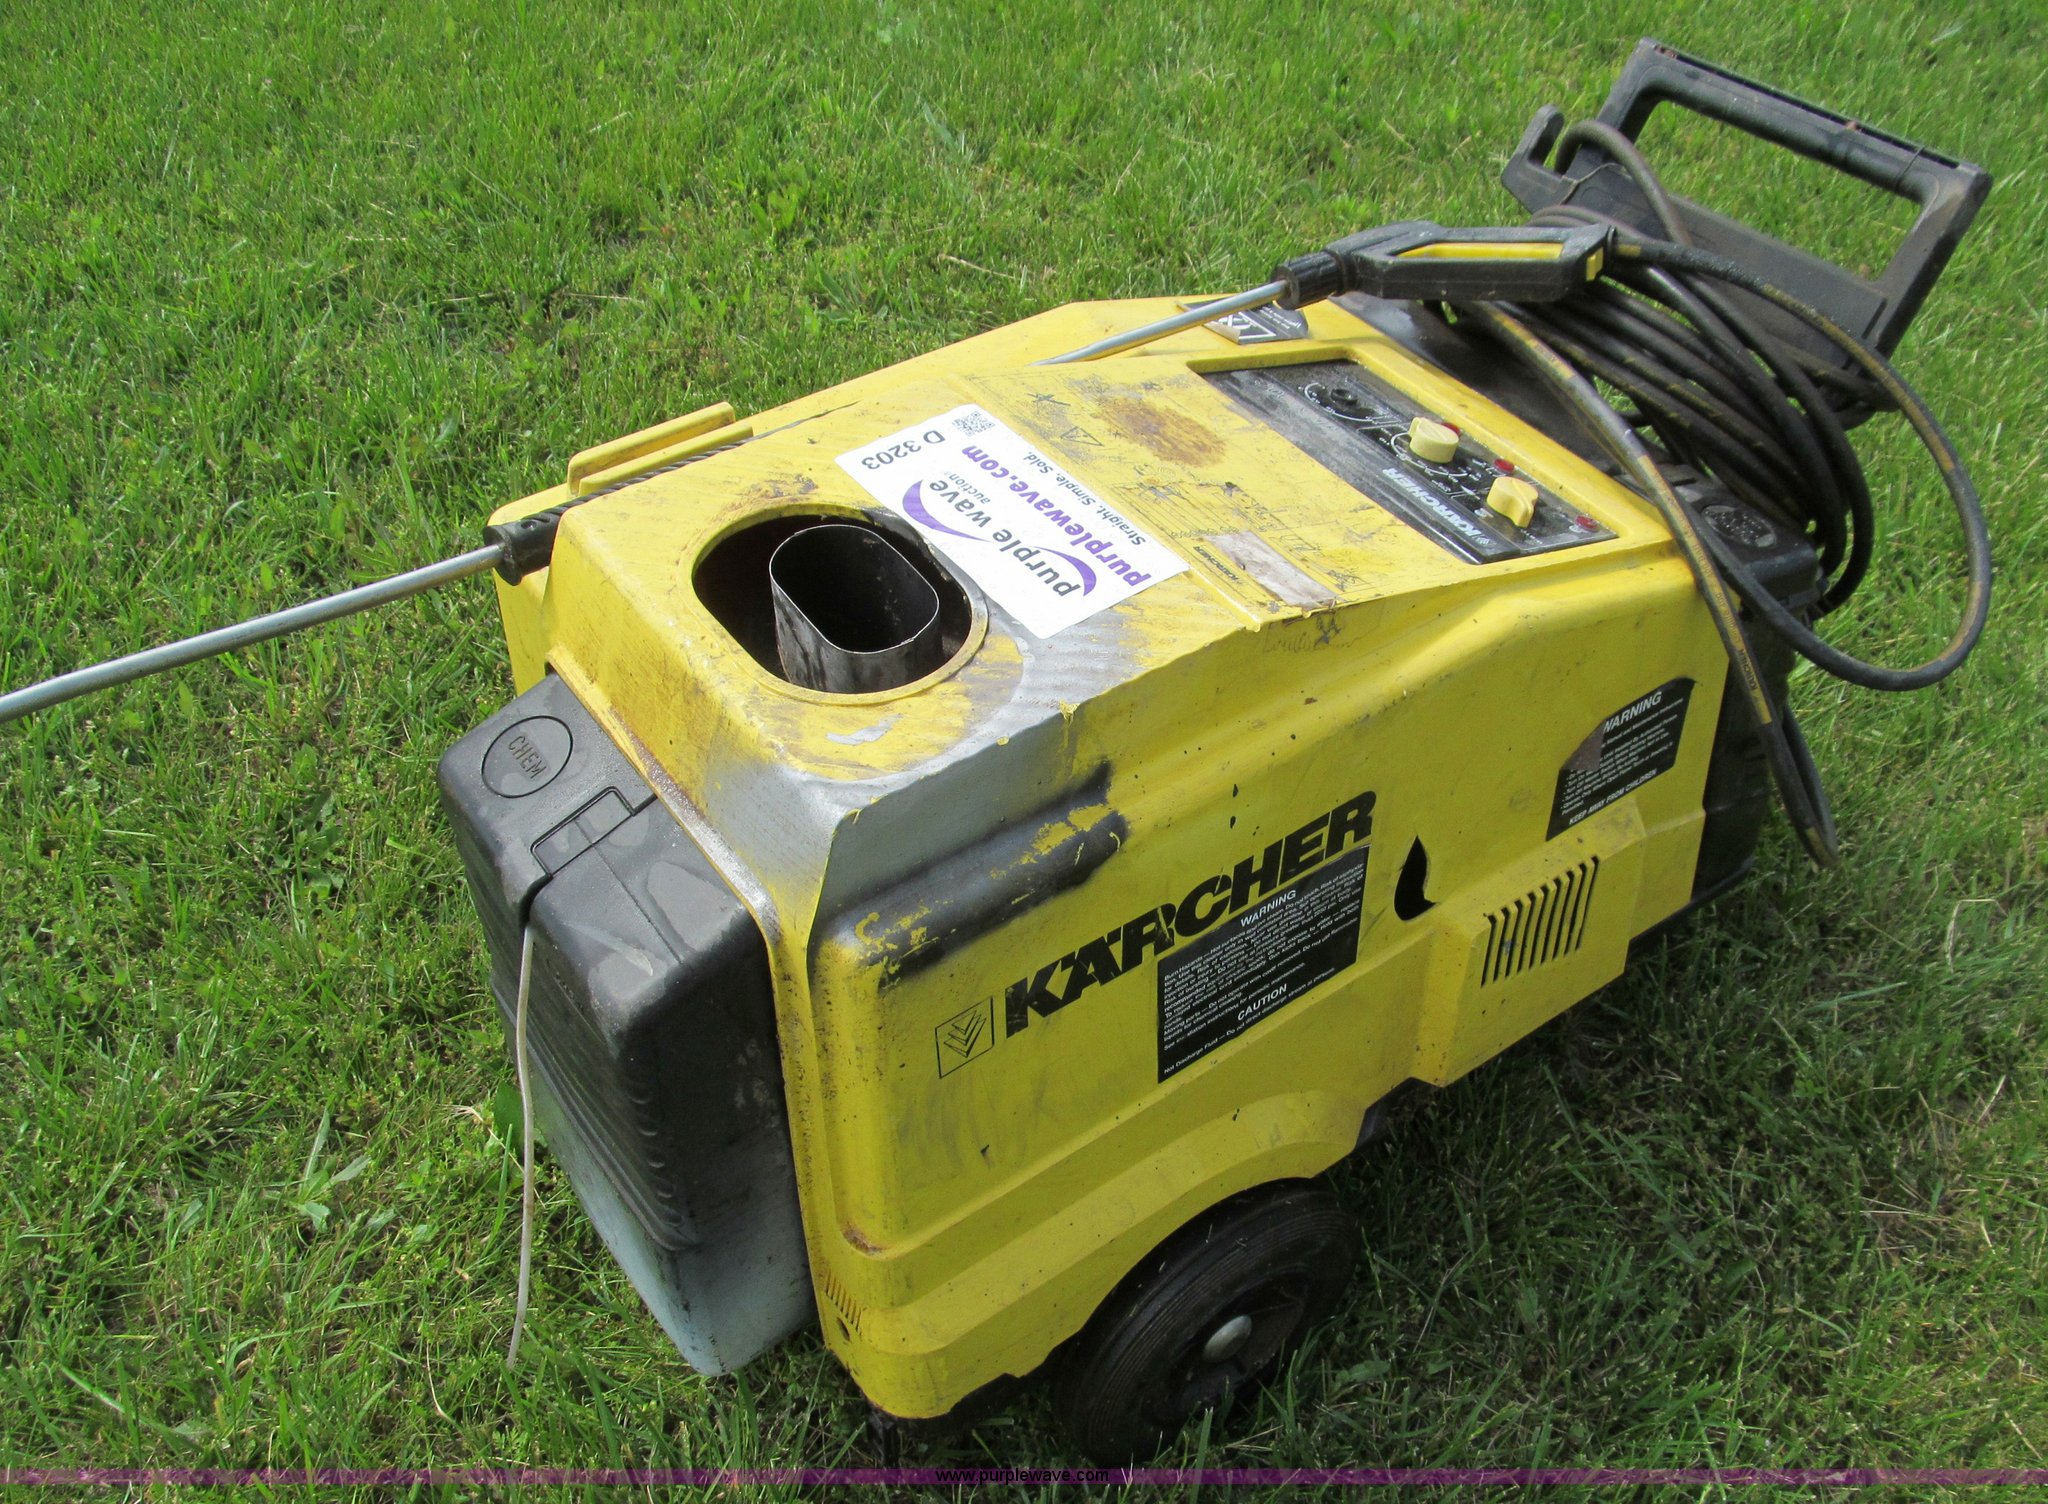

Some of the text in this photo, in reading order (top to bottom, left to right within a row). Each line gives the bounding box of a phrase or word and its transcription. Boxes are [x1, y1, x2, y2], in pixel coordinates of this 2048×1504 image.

[861, 430, 946, 470] D 3203
[961, 444, 1152, 588] purplewave.com
[1023, 451, 1147, 547] Straight. Simple. Sold.
[929, 480, 1081, 597] purple wave
[508, 735, 547, 779] CHEM
[1240, 889, 1296, 928] WARNING
[1237, 983, 1288, 1022] CAUTION
